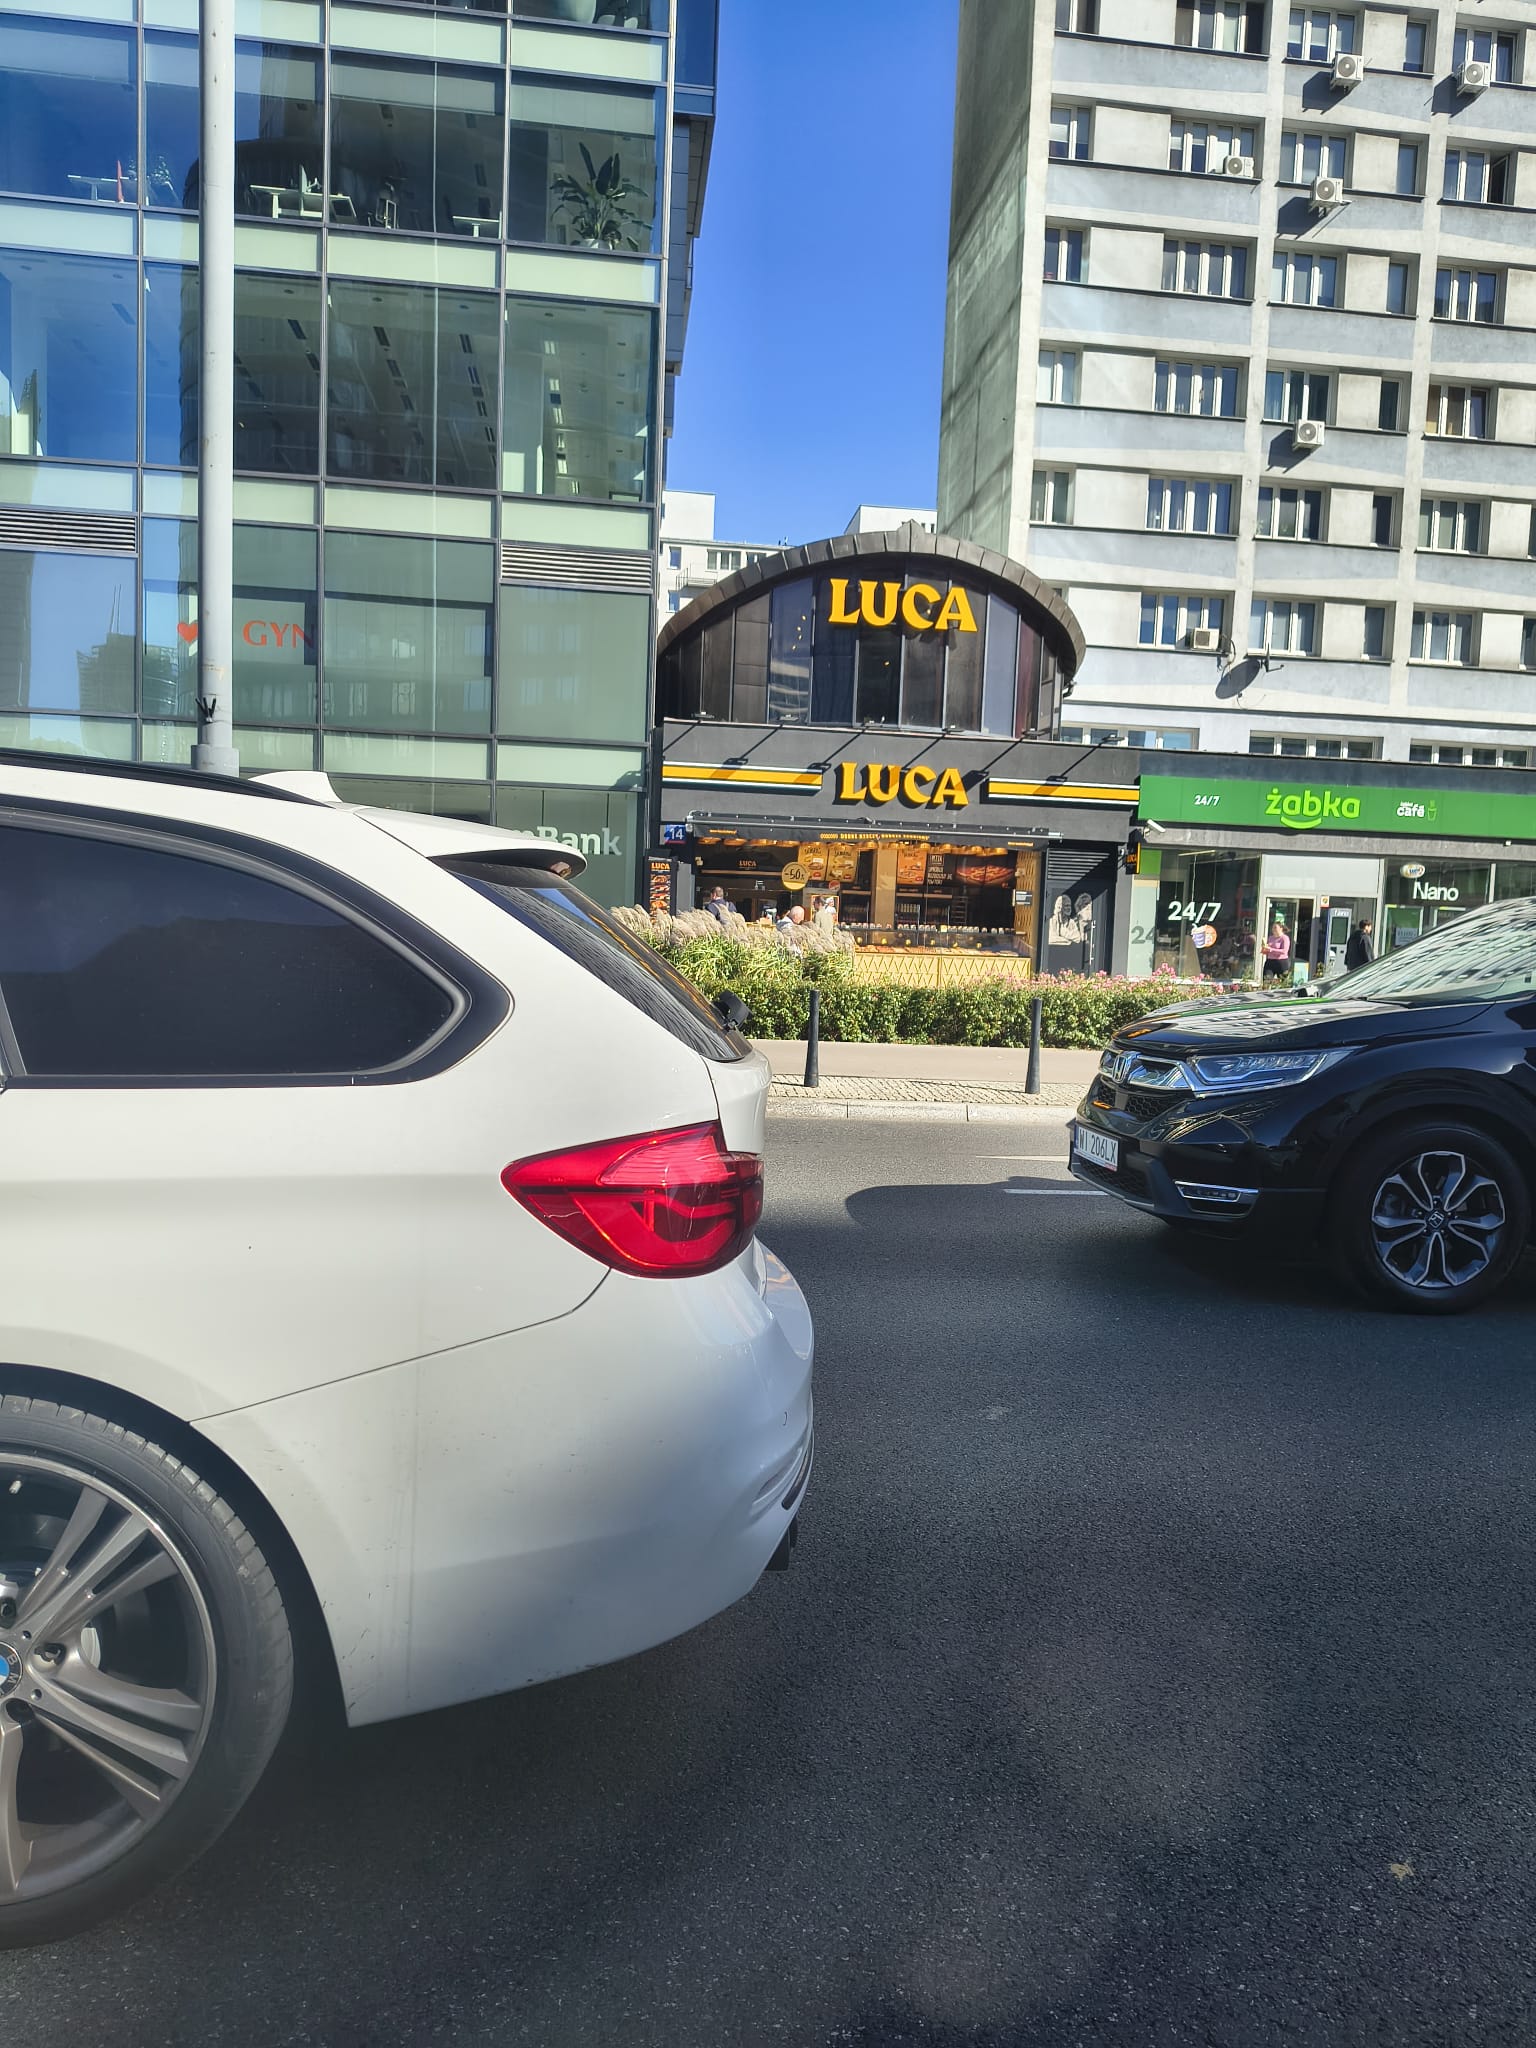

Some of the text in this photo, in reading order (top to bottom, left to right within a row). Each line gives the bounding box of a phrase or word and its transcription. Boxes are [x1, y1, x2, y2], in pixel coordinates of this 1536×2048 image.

[829, 578, 977, 632] LUCA
[242, 620, 314, 648] GYN
[840, 762, 968, 806] LUCA
[1194, 794, 1220, 806] 24/7
[1265, 788, 1360, 819] żabka
[1396, 803, 1425, 818] café
[511, 826, 622, 856] Bank
[669, 828, 683, 841] 14
[651, 862, 671, 871] LUCA
[739, 859, 757, 867] LUCA
[1412, 881, 1459, 902] Nano
[1168, 900, 1222, 923] 24/7
[1091, 1134, 1117, 1164] 206LX
